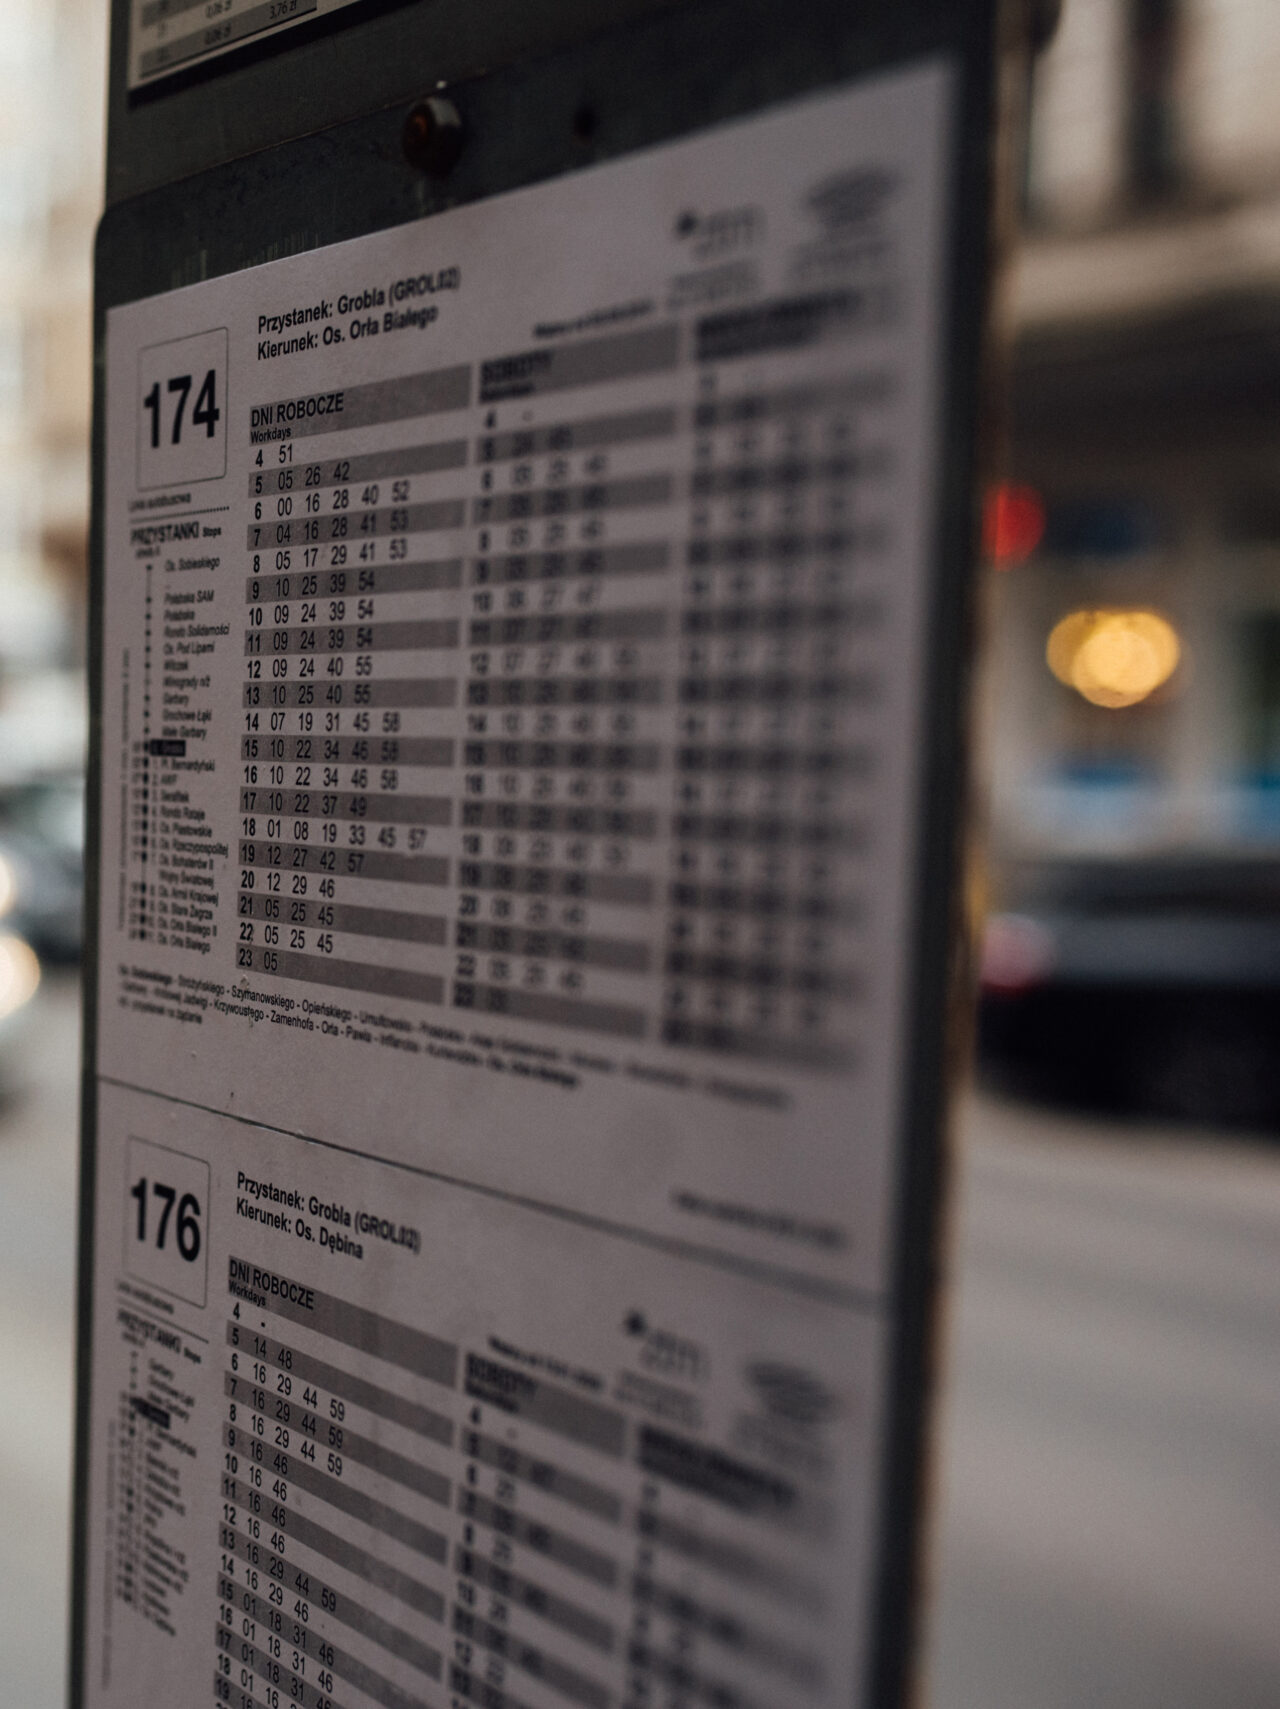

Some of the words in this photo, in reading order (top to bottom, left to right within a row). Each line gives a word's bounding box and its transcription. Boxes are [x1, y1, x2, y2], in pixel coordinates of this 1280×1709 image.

[258, 299, 333, 334] Przystanek:
[337, 287, 385, 314] Grobla
[257, 331, 318, 360] Kierunek:
[322, 326, 345, 346] Os.
[350, 316, 379, 340] Orła
[383, 305, 439, 332] Białego
[143, 369, 220, 449] 174
[251, 406, 273, 427] DNI
[277, 392, 344, 423] ROBOCZE
[250, 427, 291, 443] Workdays
[255, 449, 263, 467] 4
[279, 443, 292, 464] 51
[255, 475, 263, 494] 5
[278, 470, 293, 490] 05
[305, 465, 321, 486] 26
[333, 461, 350, 481] 42
[255, 502, 262, 520] 6
[277, 496, 292, 517] 00
[306, 493, 320, 512] 16
[332, 489, 349, 510] 28
[254, 528, 261, 546] 7
[276, 524, 291, 543] 04
[304, 520, 319, 540] 16
[331, 517, 348, 537] 28
[253, 554, 260, 573] 8
[276, 550, 291, 570] 05
[304, 548, 318, 567] 17
[331, 544, 347, 565] 29
[252, 581, 259, 599] 9
[276, 578, 290, 597] 10
[302, 575, 317, 595] 25
[249, 607, 263, 626] 10
[274, 604, 289, 624] 09
[301, 603, 316, 623] 24
[329, 601, 345, 621] 39
[248, 634, 261, 652] 11
[273, 632, 288, 650] 09
[300, 630, 315, 649] 24
[247, 660, 261, 679] 12
[272, 658, 287, 678] 09
[299, 658, 315, 677] 24
[327, 657, 343, 677] 40
[246, 686, 260, 705] 13
[273, 685, 286, 704] 10
[298, 685, 314, 704] 25
[245, 713, 259, 731] 14
[270, 712, 286, 731] 07
[299, 712, 313, 731] 19
[325, 712, 340, 732] 31
[245, 739, 258, 757] 15
[270, 739, 284, 758] 10
[296, 740, 312, 758] 22
[244, 765, 257, 784] 16
[270, 765, 284, 785] 10
[295, 766, 311, 786] 22
[323, 767, 338, 787] 34
[243, 792, 257, 810] 17
[269, 793, 283, 811] 10
[294, 794, 310, 813] 22
[243, 817, 256, 837] 18
[267, 819, 281, 838] 01
[294, 821, 309, 841] 08
[322, 823, 337, 843] 19
[241, 844, 255, 862] 19
[268, 846, 281, 865] 12
[293, 848, 308, 867] 27
[320, 851, 335, 870] 42
[241, 870, 255, 889] 20
[267, 872, 281, 892] 12
[292, 874, 307, 895] 29
[319, 878, 335, 898] 46
[240, 896, 254, 917] 21
[265, 899, 279, 918] 05
[291, 902, 306, 922] 25
[318, 906, 334, 926] 45
[239, 922, 254, 942] 22
[264, 925, 279, 945] 05
[290, 929, 305, 949] 25
[317, 933, 333, 954] 45
[238, 948, 252, 967] 23
[264, 952, 278, 975] 05
[231, 985, 295, 1010] Szymanowskiego
[271, 1009, 314, 1031] Zamenhofa
[237, 1171, 304, 1211] Przystanek:
[309, 1196, 351, 1227] Grobla
[130, 1175, 201, 1262] 176
[236, 1197, 291, 1234] Kierunek:
[295, 1218, 315, 1242] Os.
[320, 1226, 363, 1260] Dębina
[229, 1280, 266, 1307] Workdays
[230, 1259, 249, 1283] DNI
[253, 1268, 314, 1310] ROBOCZE
[233, 1302, 240, 1320] 4
[232, 1328, 239, 1345] 5
[254, 1336, 267, 1357] 14
[278, 1348, 292, 1369] 48
[231, 1353, 238, 1371] 6
[253, 1363, 266, 1384] 16
[277, 1373, 292, 1396] 29
[303, 1387, 318, 1409] 44
[330, 1398, 345, 1422] 59
[230, 1378, 237, 1395] 7
[252, 1389, 265, 1409] 16
[276, 1400, 290, 1422] 29
[301, 1414, 316, 1434] 44
[328, 1426, 343, 1448] 59
[228, 1429, 235, 1447] 9
[251, 1440, 263, 1461] 16
[273, 1454, 288, 1474] 46
[229, 1404, 236, 1422] 8
[251, 1414, 264, 1436] 16
[275, 1426, 289, 1449] 29
[300, 1440, 315, 1462] 44
[327, 1452, 342, 1477] 59
[225, 1453, 238, 1474] 10
[249, 1465, 262, 1487] 16
[272, 1479, 287, 1502] 46
[224, 1478, 236, 1498] 11
[249, 1491, 261, 1512] 16
[271, 1506, 286, 1527] 46
[223, 1504, 236, 1525] 12
[247, 1517, 260, 1539] 16
[270, 1532, 285, 1554] 46
[222, 1529, 235, 1549] 13
[247, 1543, 259, 1564] 16
[270, 1557, 284, 1579] 29
[295, 1573, 309, 1595] 44
[321, 1587, 336, 1612] 59
[221, 1554, 234, 1575] 14
[246, 1568, 258, 1590] 16
[269, 1582, 283, 1606] 29
[294, 1600, 309, 1623] 46
[243, 1593, 256, 1615] 01
[269, 1610, 282, 1631] 18
[293, 1625, 306, 1649] 31
[319, 1643, 334, 1666] 46
[220, 1604, 232, 1626] 16
[243, 1618, 255, 1641] 01
[268, 1635, 281, 1658] 18
[292, 1651, 305, 1675] 31
[318, 1670, 333, 1693] 46
